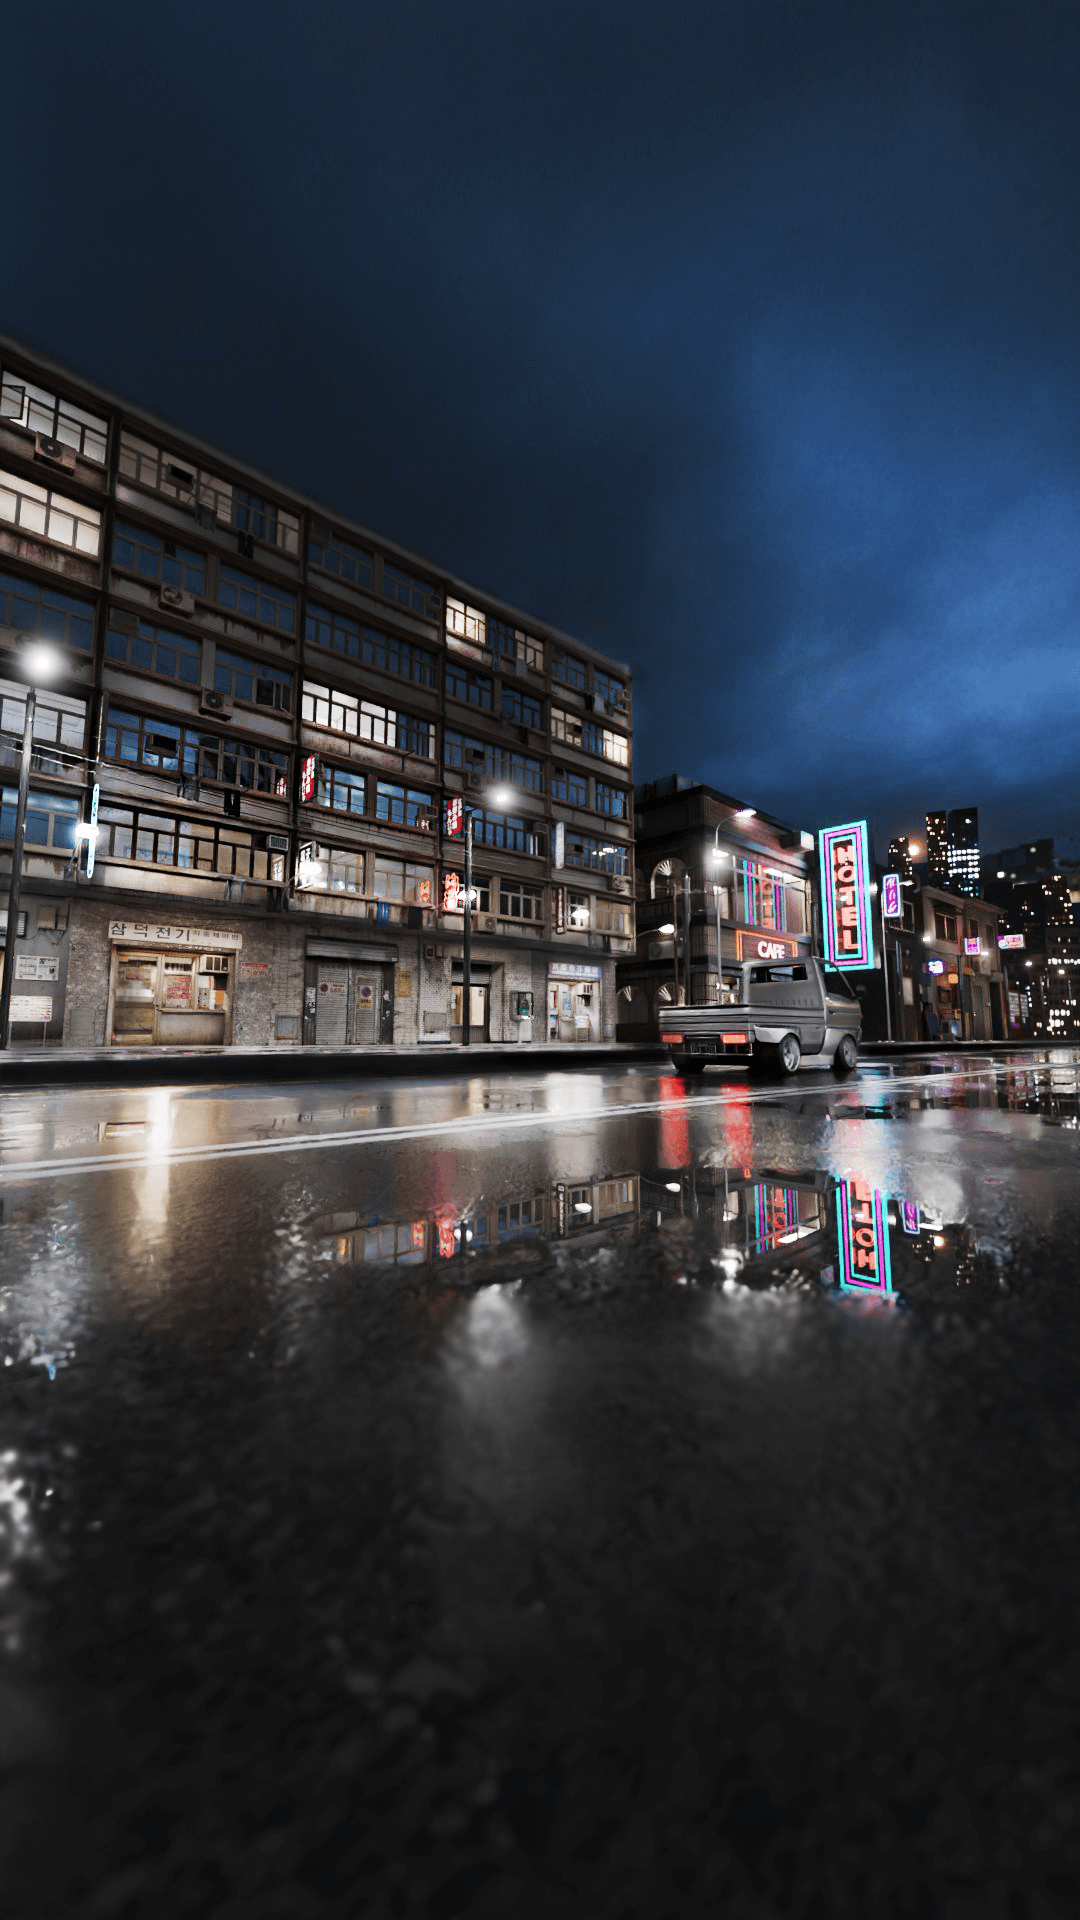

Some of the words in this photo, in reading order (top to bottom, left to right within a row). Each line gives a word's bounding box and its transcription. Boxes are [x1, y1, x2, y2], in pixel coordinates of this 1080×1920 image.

[836, 844, 859, 949] HOTEL
[111, 922, 190, 942] 삼덕전기
[757, 940, 786, 960] CAFE
